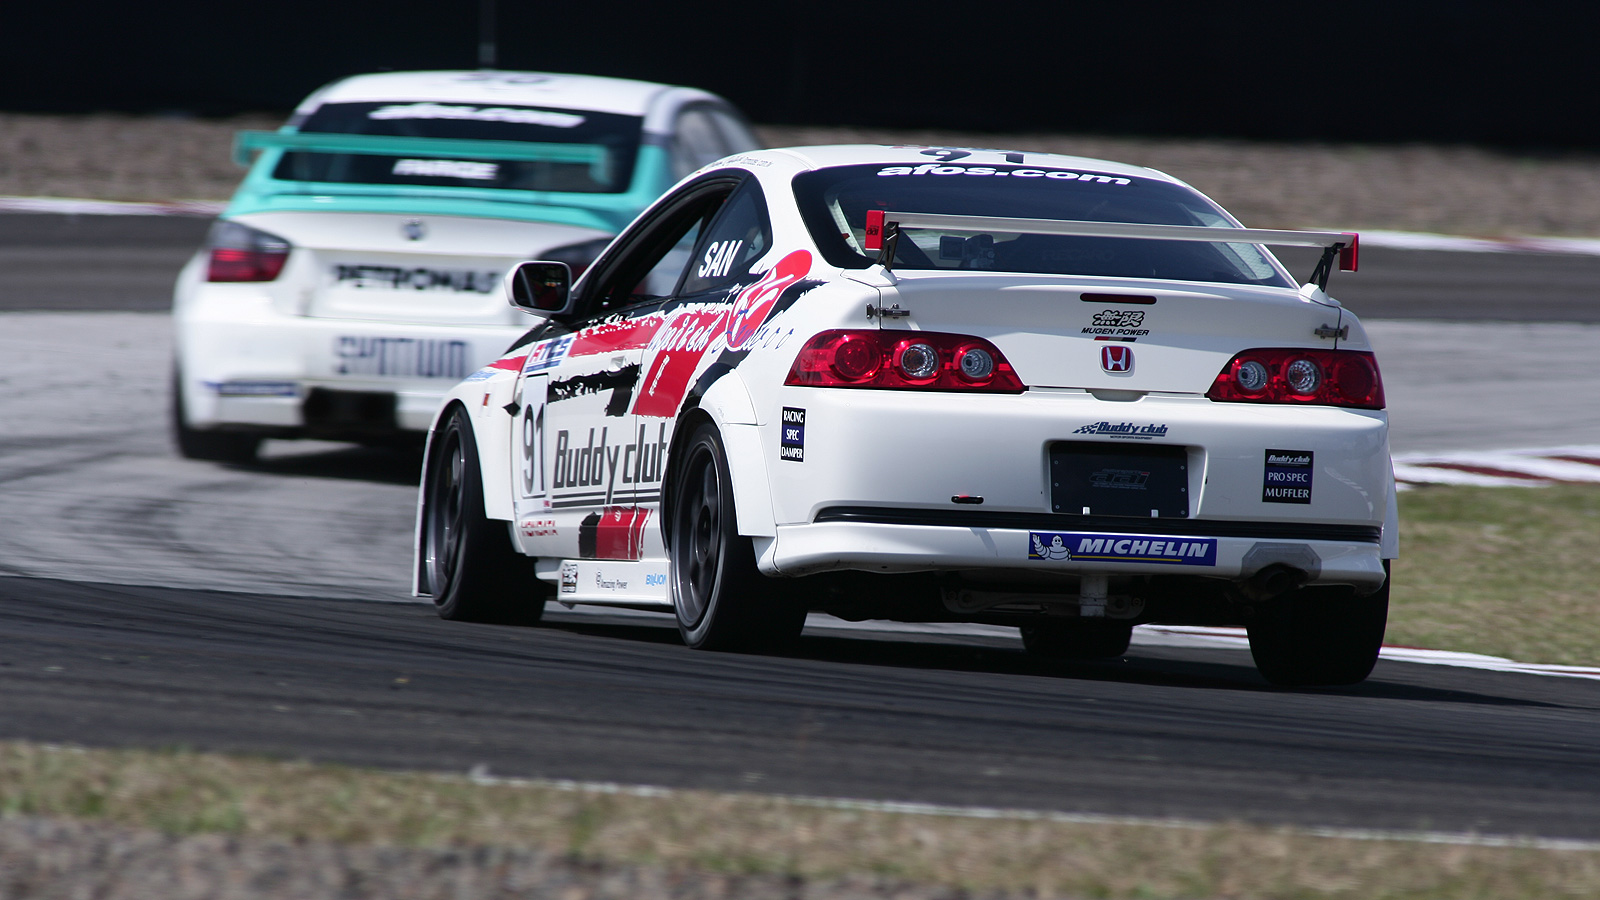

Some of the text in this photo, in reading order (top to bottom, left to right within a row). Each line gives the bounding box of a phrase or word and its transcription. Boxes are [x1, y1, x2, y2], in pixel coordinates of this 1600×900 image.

[877, 164, 1132, 186] afos.com
[698, 239, 743, 278] SAN
[1092, 309, 1145, 327] 無限
[1081, 327, 1150, 336] MUGEN POWER
[783, 410, 804, 423] RACING
[1097, 421, 1168, 435] Buddy club
[786, 429, 800, 441] SPEC
[523, 403, 546, 494] 91
[781, 446, 803, 459] DAMPER
[553, 422, 667, 504] Buddy club
[1268, 454, 1310, 464] Buddy club
[1268, 472, 1308, 482] PRO SPEC
[1265, 487, 1310, 499] MUFFLER
[1077, 538, 1209, 558] MICHELIN
